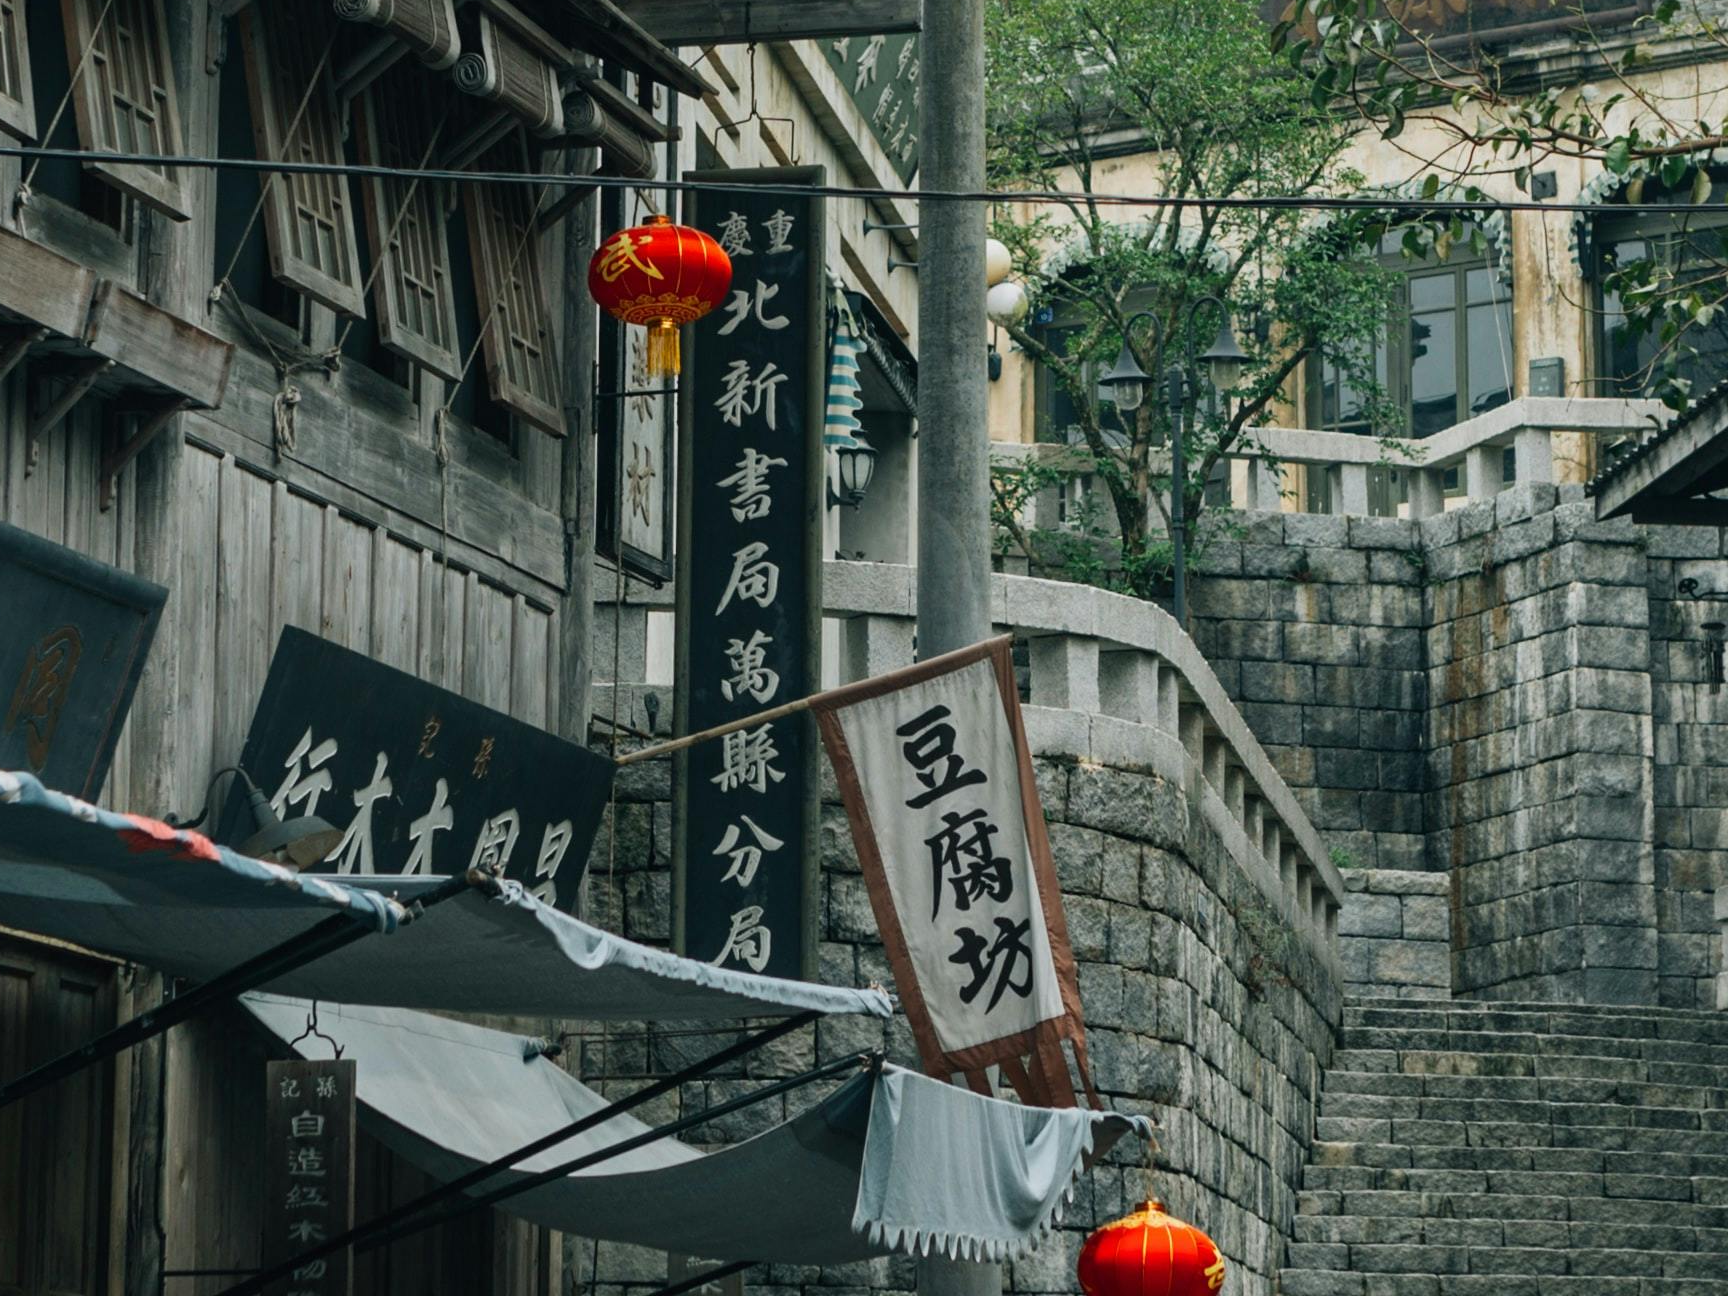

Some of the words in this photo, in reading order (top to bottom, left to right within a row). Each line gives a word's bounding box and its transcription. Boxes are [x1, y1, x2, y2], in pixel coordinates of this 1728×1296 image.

[712, 279, 792, 974] 北新書局萬縣分局
[895, 703, 1035, 1016] 豆腐坊
